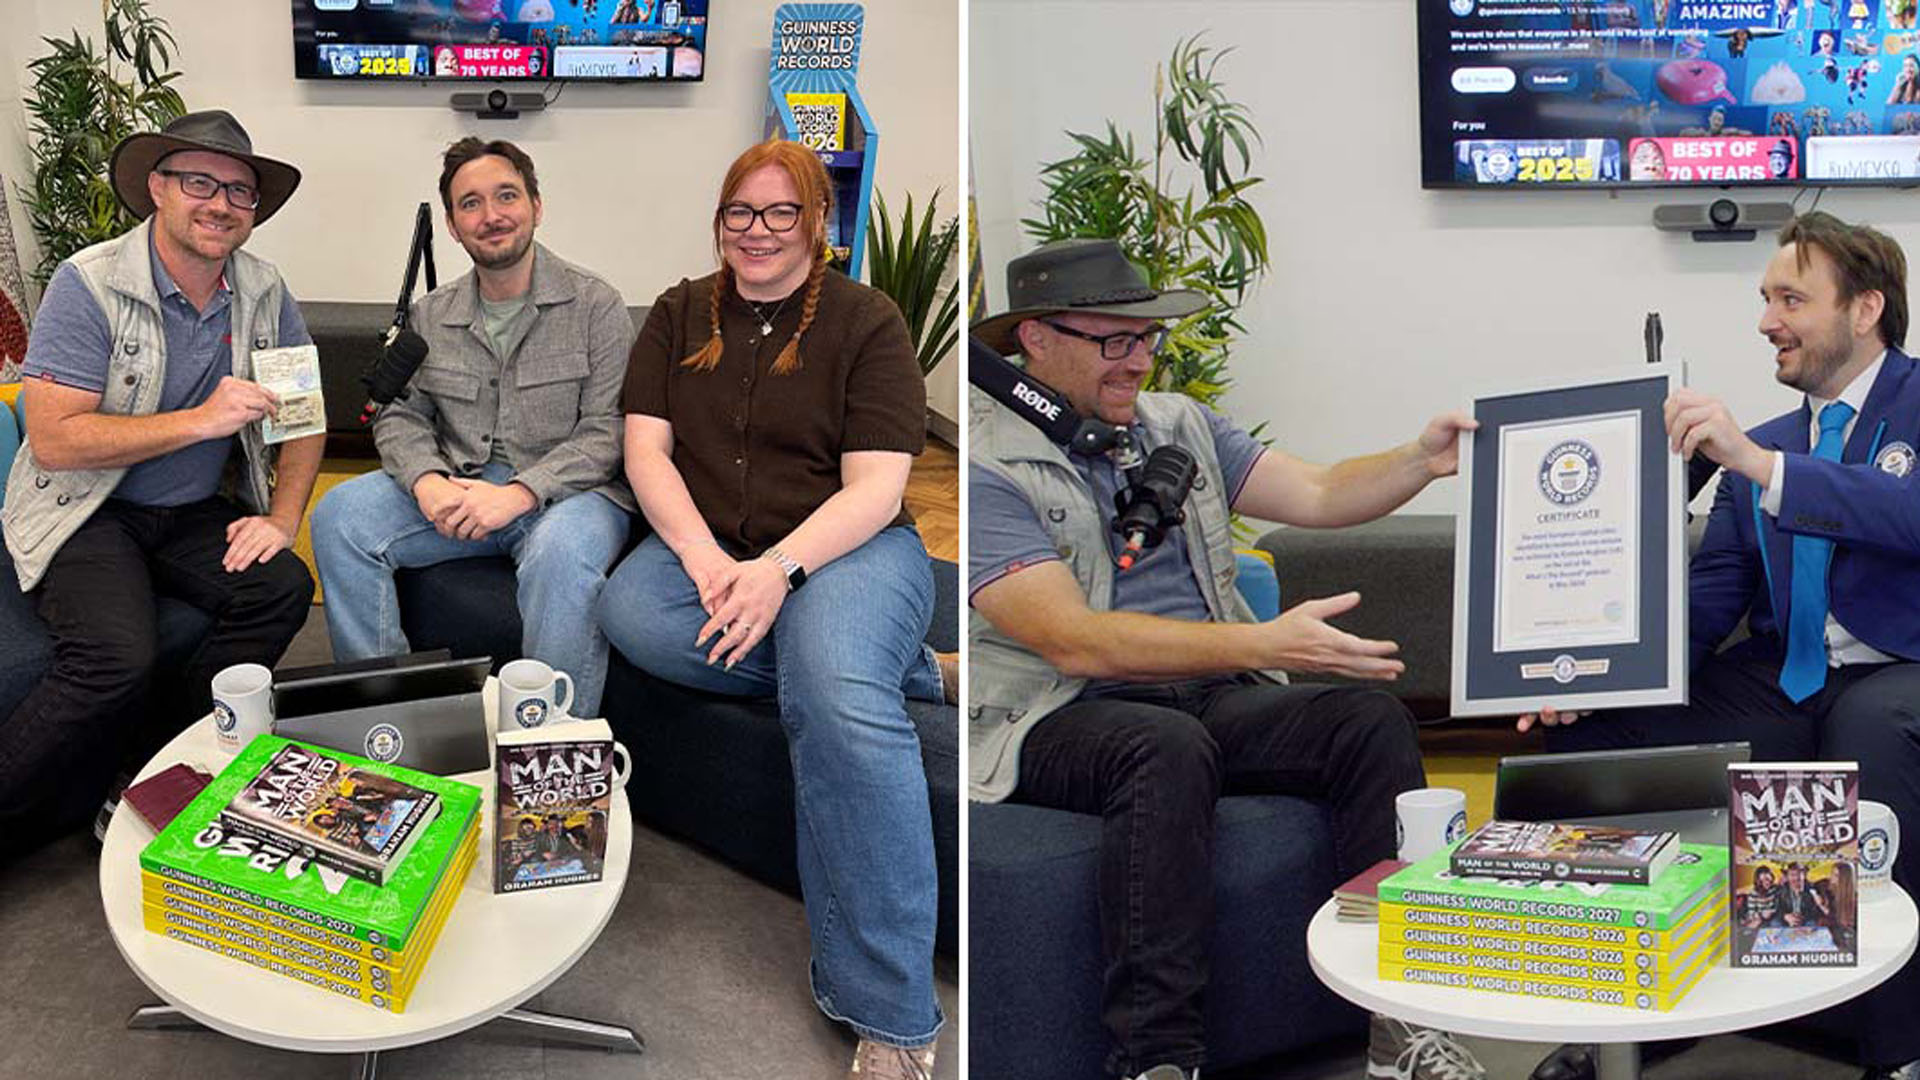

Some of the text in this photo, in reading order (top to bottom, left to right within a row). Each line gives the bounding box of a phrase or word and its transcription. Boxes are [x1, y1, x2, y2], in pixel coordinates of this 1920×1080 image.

[1679, 4, 1768, 20] AMAZING
[781, 20, 857, 35] GUINNESS
[463, 48, 522, 61] BEST OF
[781, 36, 855, 54] WORLD
[359, 58, 411, 75] 2025
[460, 66, 526, 77] 70 YEARS
[777, 55, 852, 69] RECORDS
[1452, 121, 1487, 132] For you
[1516, 146, 1565, 157] BEST OF
[1673, 141, 1758, 158] BEST OF
[1516, 157, 1594, 182] 2025
[1668, 166, 1766, 180] 70 YEARS
[1546, 443, 1592, 464] GUINNESS
[1536, 508, 1601, 524] CERTIFICATE
[509, 747, 602, 785] MAN
[256, 751, 310, 814] MAN
[283, 759, 338, 821] WORLD
[533, 774, 584, 792] OF THE
[512, 781, 608, 810] WORLD
[1741, 778, 1846, 822] MAN
[1768, 811, 1826, 832] OF THE
[1745, 822, 1855, 854] WORLD
[1457, 858, 1482, 867] MAN
[1511, 859, 1551, 871] WORLD
[503, 879, 553, 892] GRAHAM
[160, 865, 355, 935] GUINNESS WORLD RECORDS 2027
[1402, 889, 1621, 923] GUINNESS WORLD RECORDS 2027
[164, 882, 362, 953] GUINNESS WORLD RECORDS 2026
[1404, 909, 1625, 943] GUINNESS WORLD RECORDS 2026
[164, 896, 221, 923] GUINNESS
[329, 951, 360, 971] 2026
[165, 911, 222, 938] GUINNESS
[330, 966, 362, 982] 2026
[1403, 929, 1624, 964] GUINNESS WORLD RECORDS 2026
[1403, 947, 1625, 983] GUINNESS WORLD RECORDS 2026
[1740, 952, 1855, 966] GRAHAM HUGHES
[329, 980, 361, 998] 2026
[1402, 968, 1624, 1005] GUINNESS WORLD RECORDS 2026
